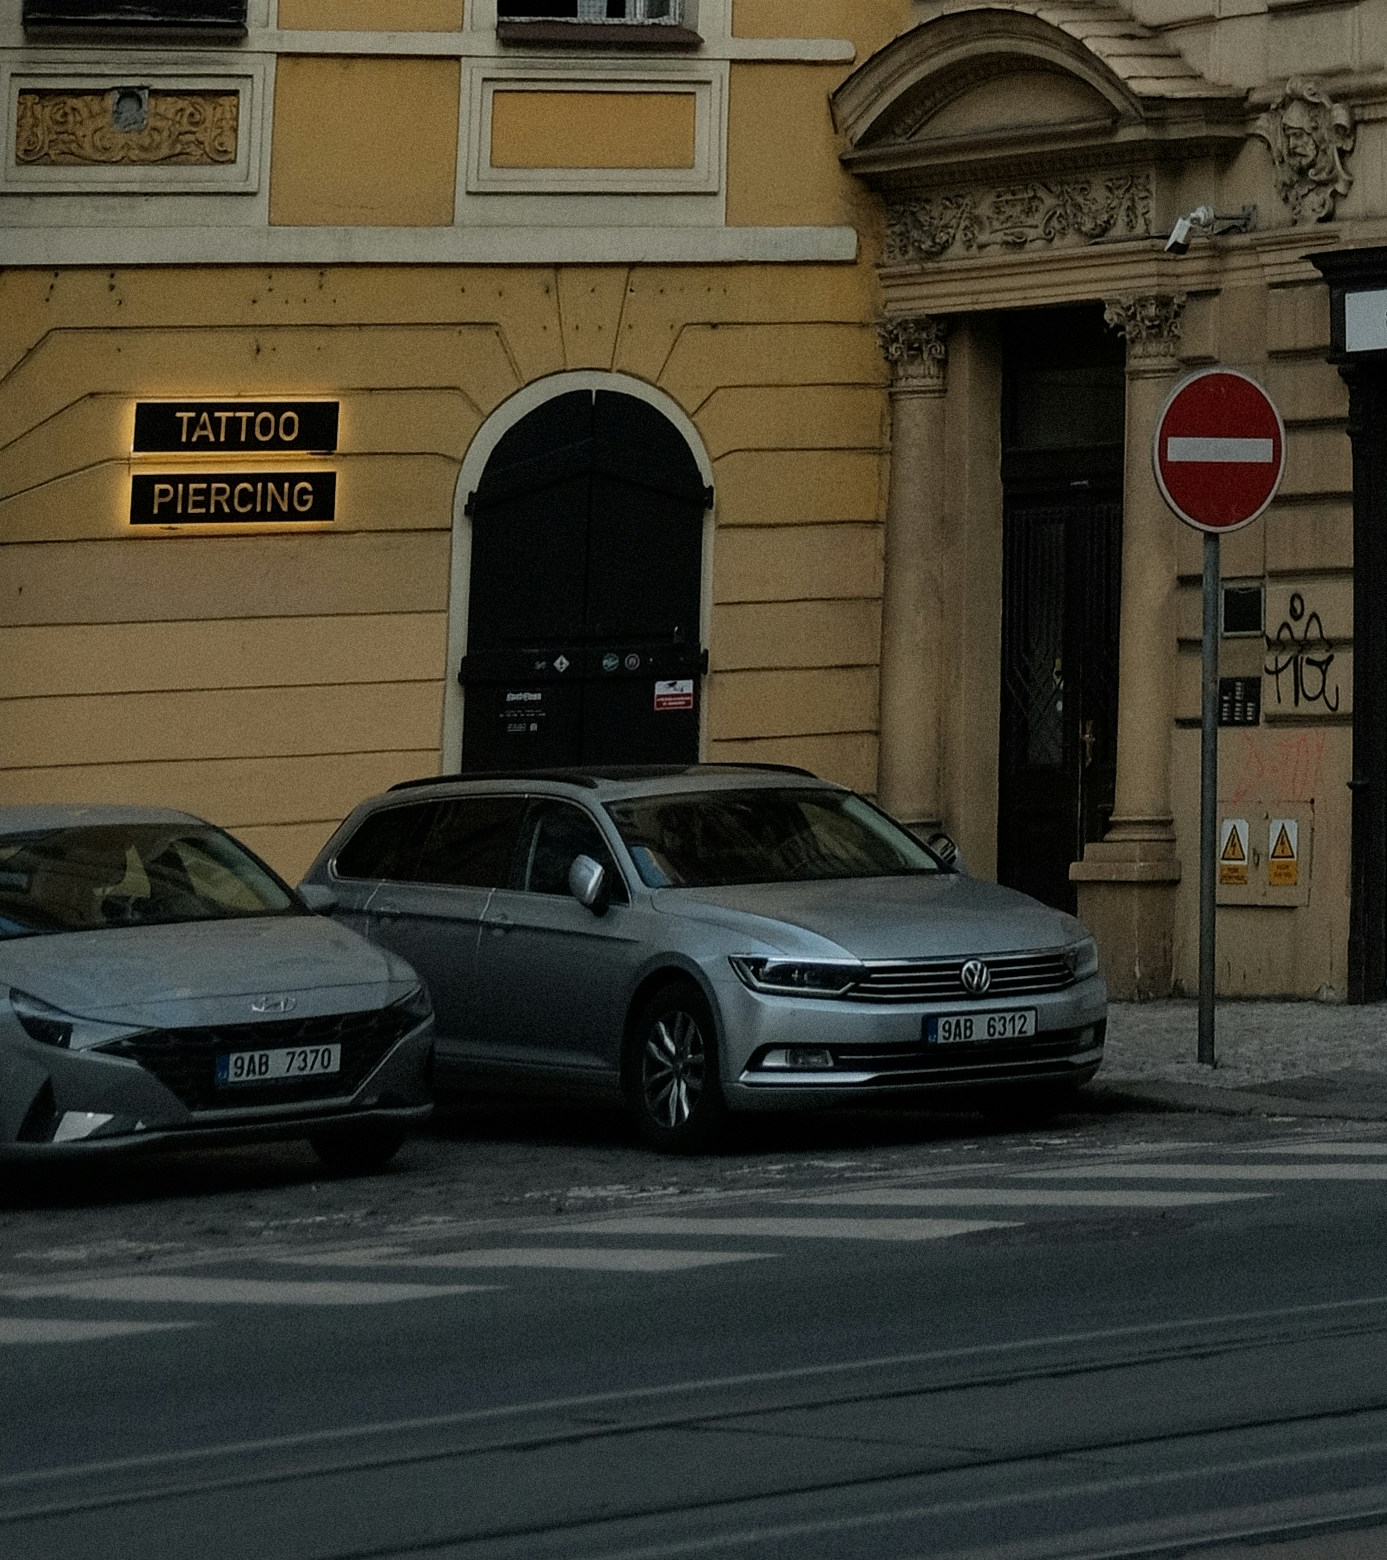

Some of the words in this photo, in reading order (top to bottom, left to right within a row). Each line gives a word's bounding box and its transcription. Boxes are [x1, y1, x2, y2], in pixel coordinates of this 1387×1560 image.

[174, 410, 300, 444] TATTOO
[152, 481, 315, 516] PIERCING
[942, 1018, 973, 1041] 9AB
[987, 1014, 1028, 1038] 6312
[233, 1052, 270, 1079] 9AB
[285, 1047, 332, 1073] 7370
